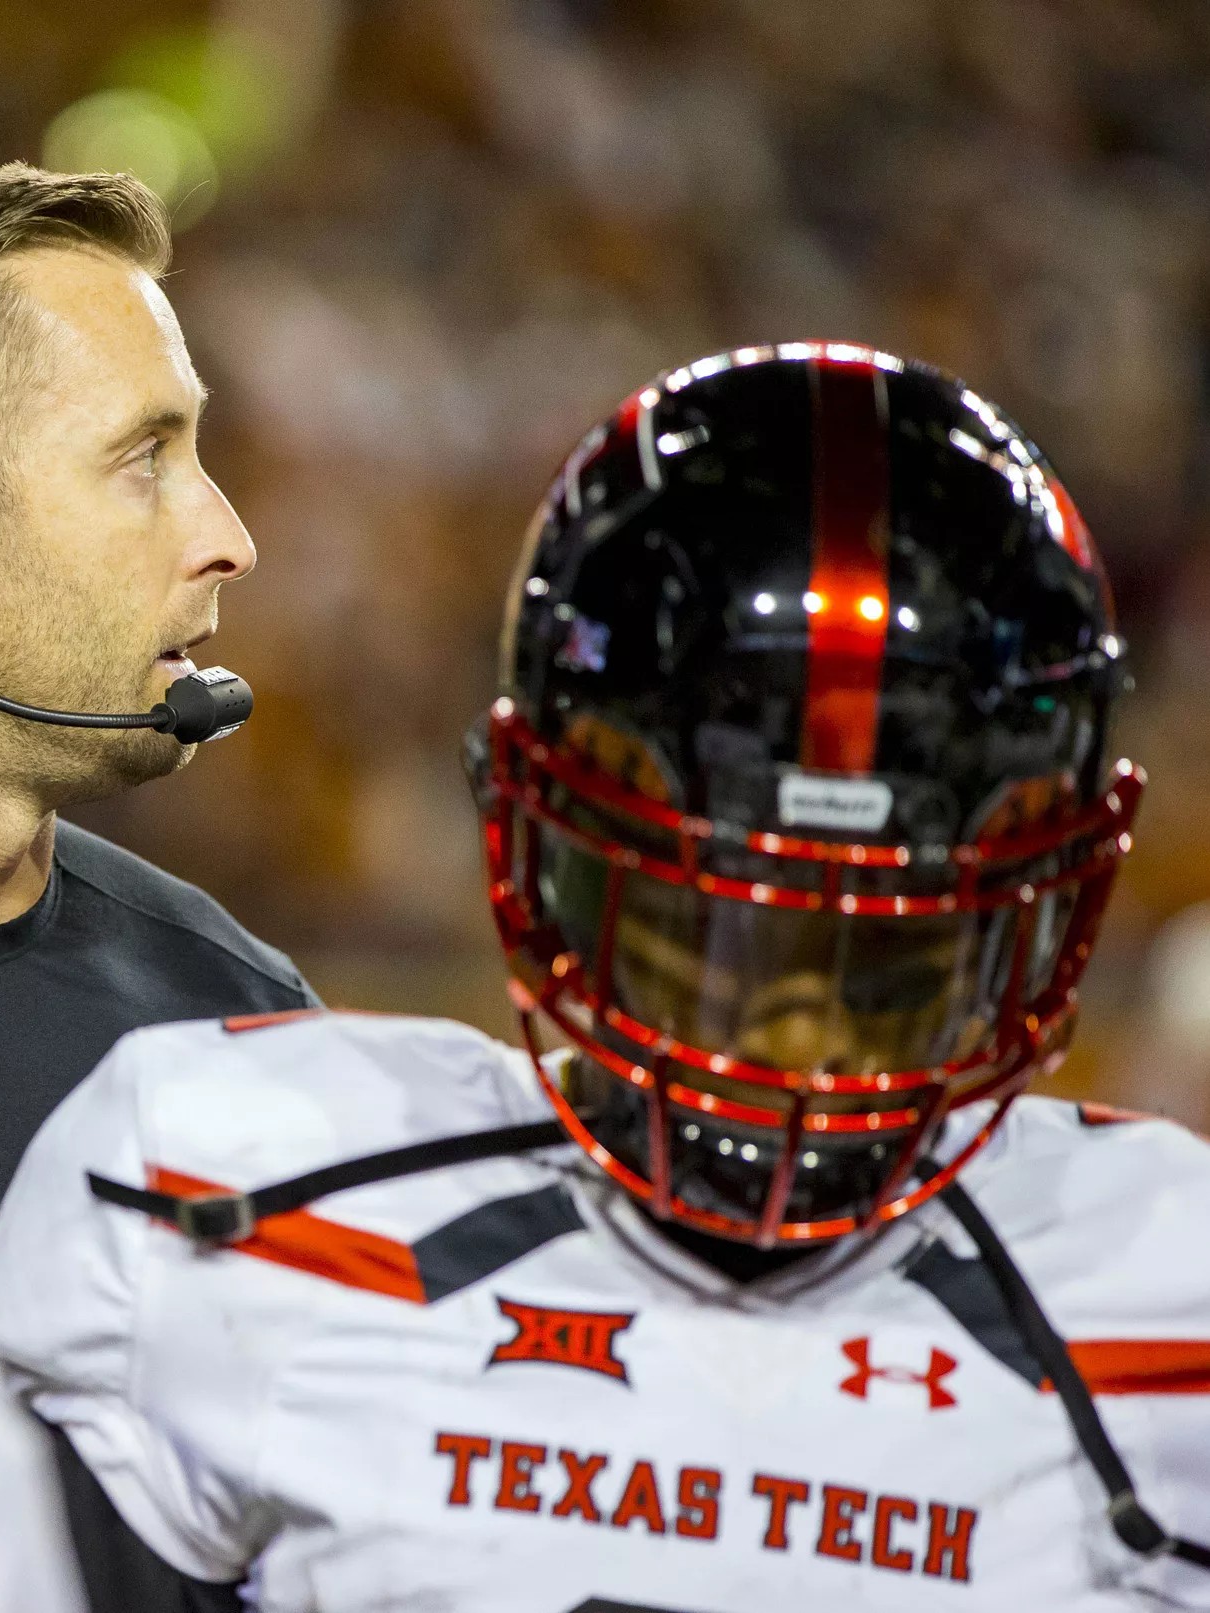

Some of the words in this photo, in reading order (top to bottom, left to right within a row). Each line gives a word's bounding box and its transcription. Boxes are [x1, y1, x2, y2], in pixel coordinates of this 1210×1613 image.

[486, 1297, 637, 1387] XII
[435, 1432, 722, 1540] TEXAS
[752, 1472, 978, 1583] TECH
